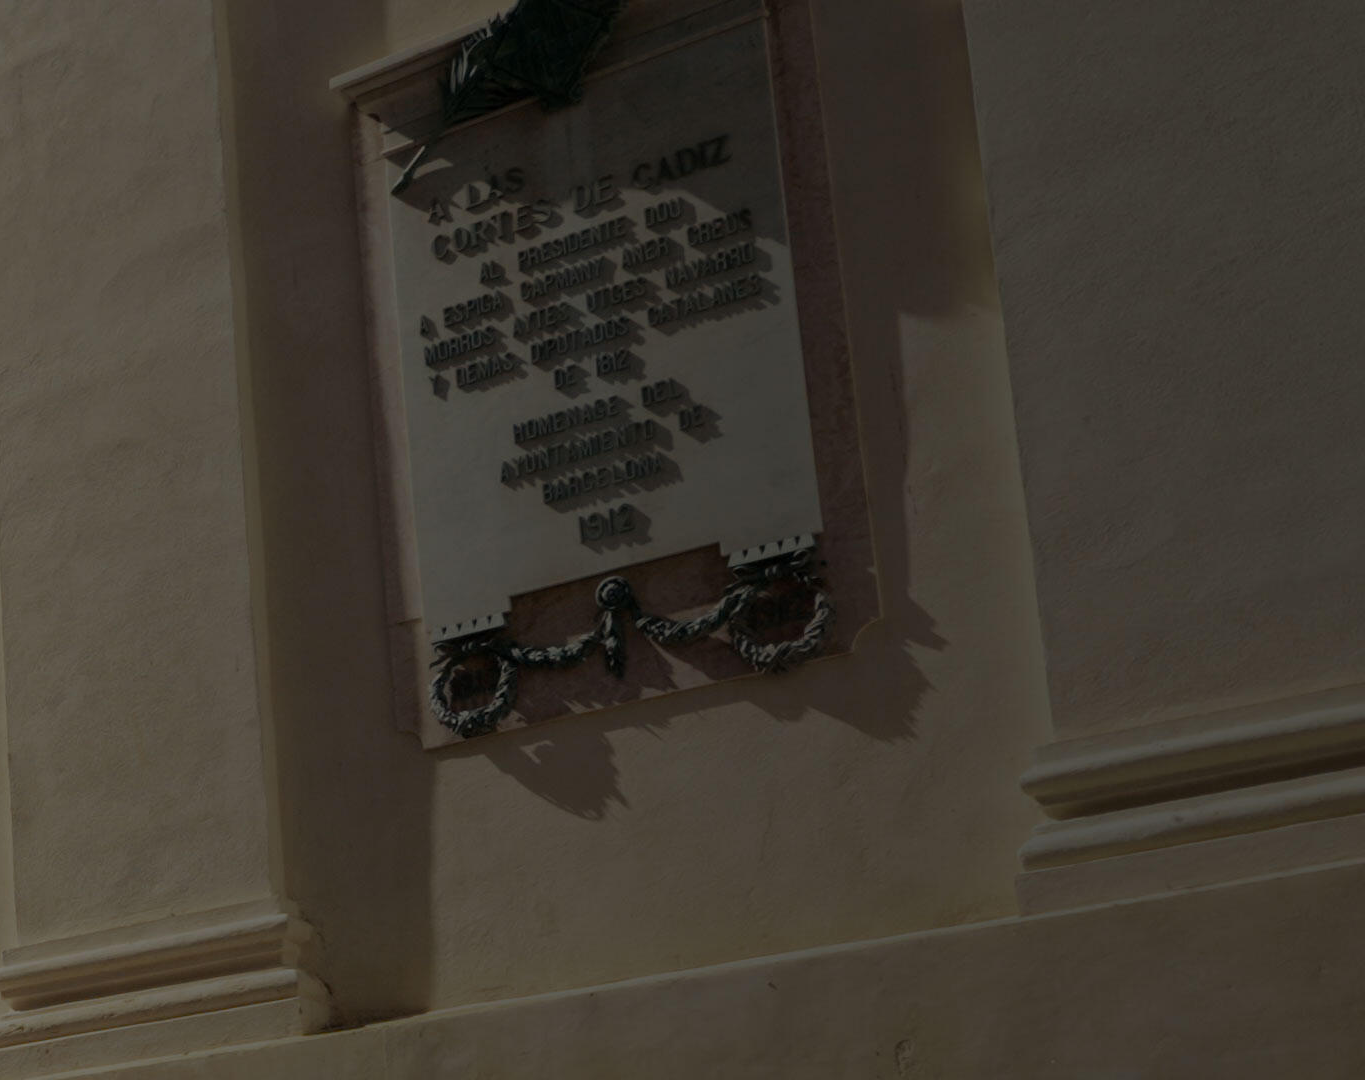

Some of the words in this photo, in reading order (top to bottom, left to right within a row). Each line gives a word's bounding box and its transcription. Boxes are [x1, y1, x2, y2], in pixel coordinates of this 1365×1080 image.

[427, 199, 451, 223] A
[466, 168, 525, 209] LAS
[430, 203, 551, 260] CORTES
[572, 174, 615, 214] DE
[631, 133, 731, 190] CADIZ
[419, 315, 432, 338] A
[443, 291, 504, 328] ESPIGA
[519, 256, 605, 304] CAPMANY
[621, 236, 671, 272] ANER
[686, 208, 753, 247] CREUS
[479, 262, 503, 285] AL
[517, 216, 629, 273] PRESIDENTE
[423, 325, 496, 368] MORROS
[586, 277, 648, 315] UTGES
[665, 243, 756, 289] NAVARRO
[456, 351, 516, 391] DEMAS
[530, 316, 631, 368] DIPUTADOS
[646, 272, 762, 328] CATALANES
[553, 364, 577, 391] DE
[595, 349, 631, 379] 1812
[500, 418, 655, 486] AYUNTAMIENTO
[678, 404, 705, 432] DE
[513, 395, 621, 445] HOMENAGE
[640, 378, 684, 408] DEL
[542, 453, 662, 505] BARCELONA
[577, 502, 637, 544] 1912
